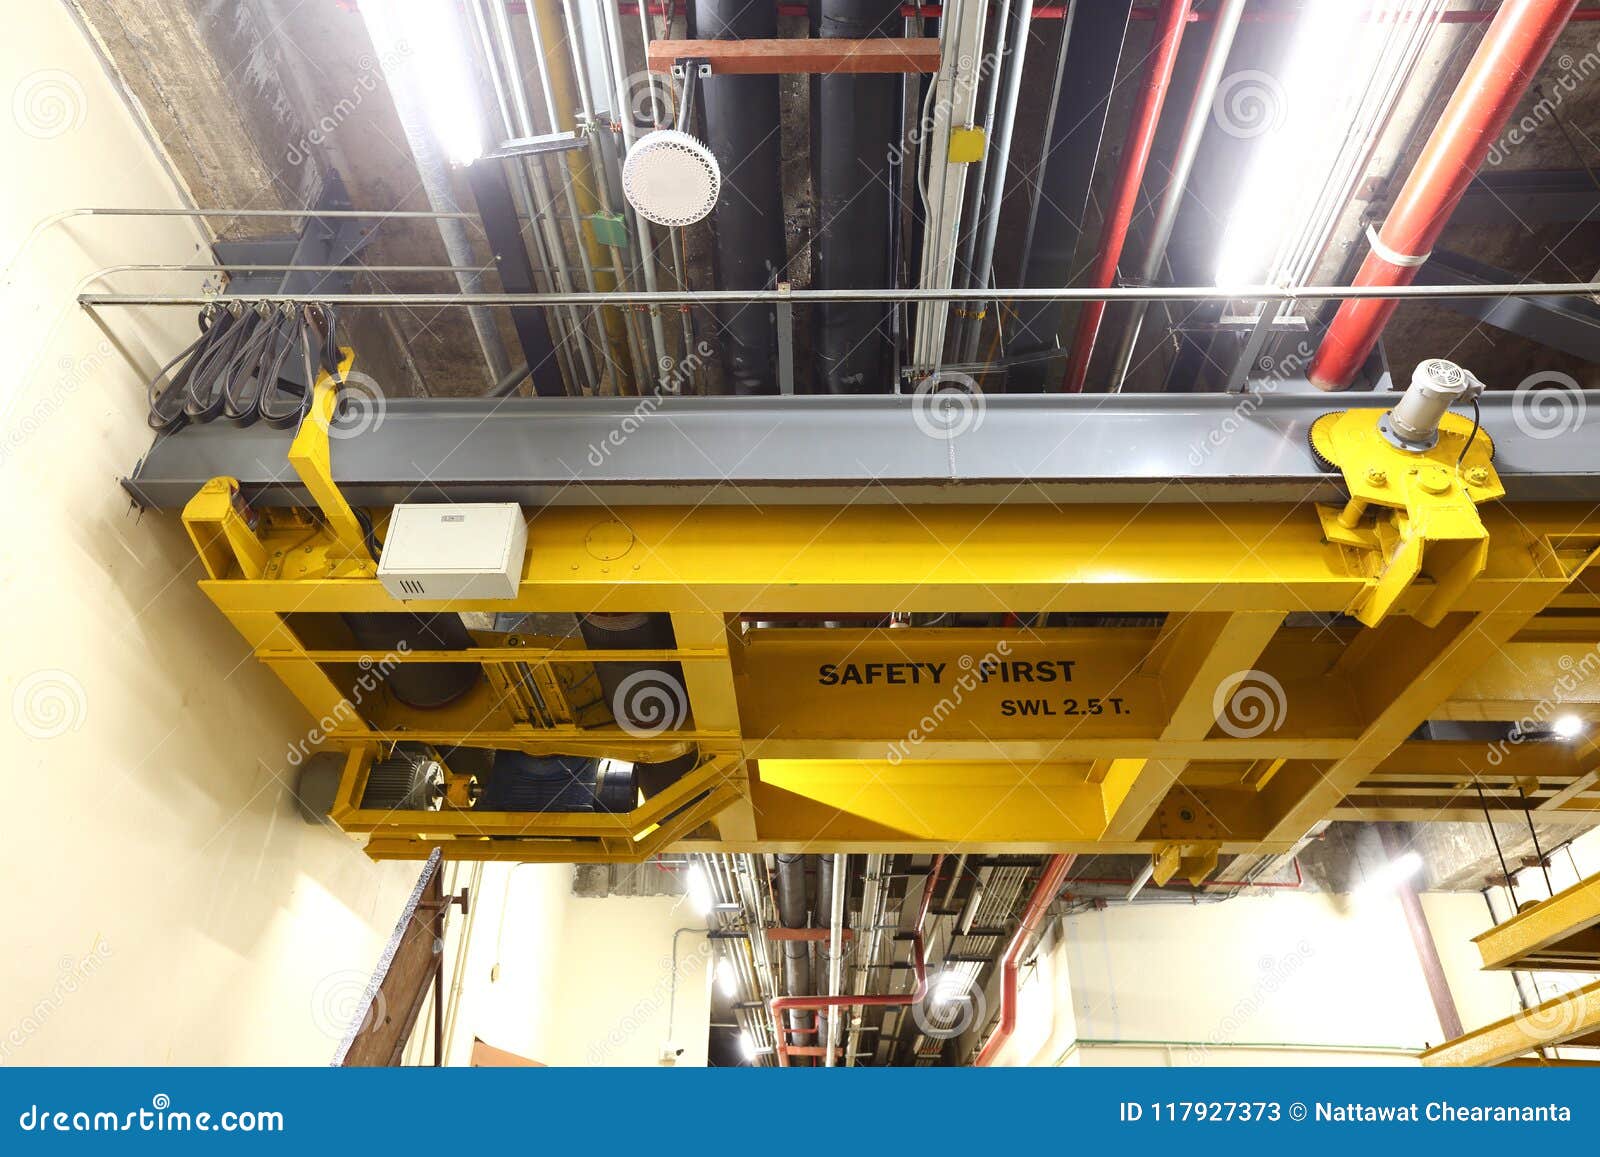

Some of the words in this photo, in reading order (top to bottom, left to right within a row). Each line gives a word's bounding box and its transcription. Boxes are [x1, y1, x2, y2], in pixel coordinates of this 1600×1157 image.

[818, 662, 947, 685] SAFETY
[980, 660, 1076, 683] FIRST
[1001, 698, 1057, 716] SWL
[1063, 698, 1104, 716] 2.5
[1109, 697, 1131, 715] T.
